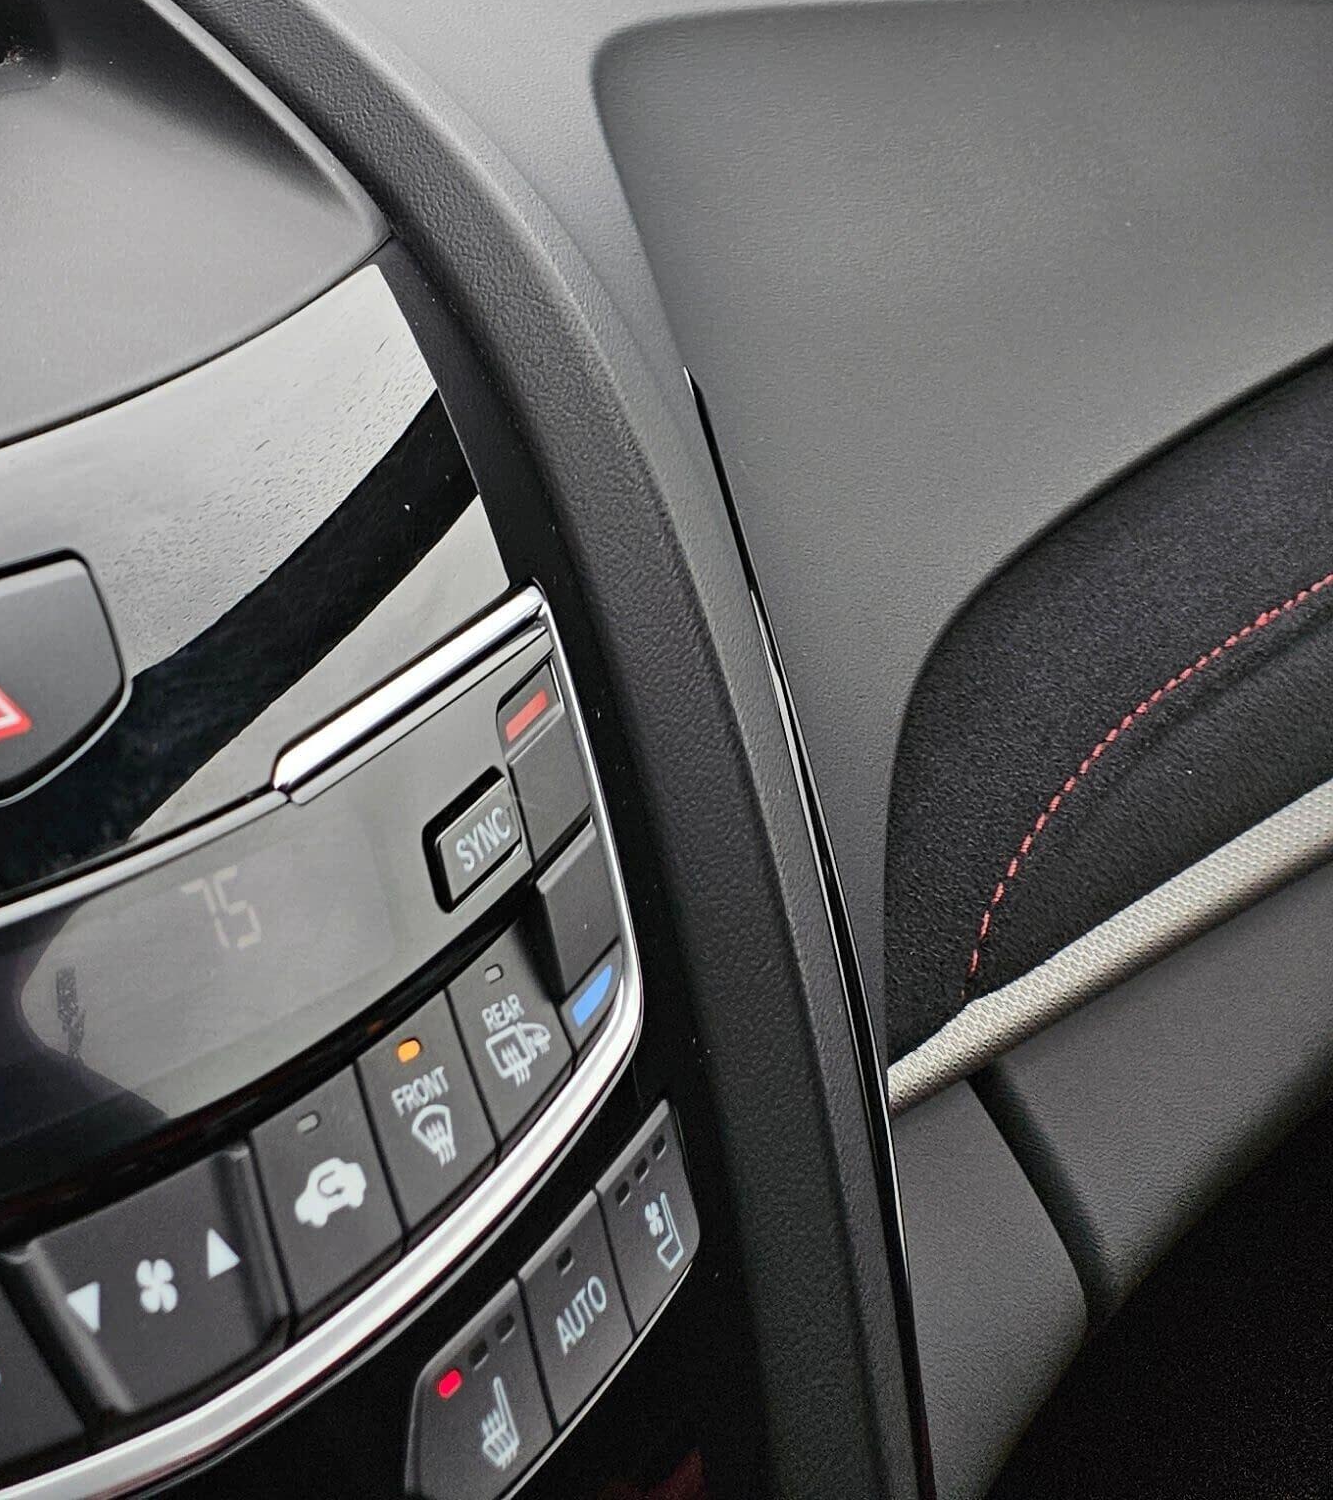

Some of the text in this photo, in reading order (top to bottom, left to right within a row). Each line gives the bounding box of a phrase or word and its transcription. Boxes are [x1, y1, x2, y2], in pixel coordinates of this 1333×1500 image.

[455, 806, 512, 872] SYNC
[181, 866, 261, 950] 75
[481, 993, 524, 1032] REAR
[391, 1065, 452, 1114] FRONT
[555, 1276, 608, 1355] AUTO
